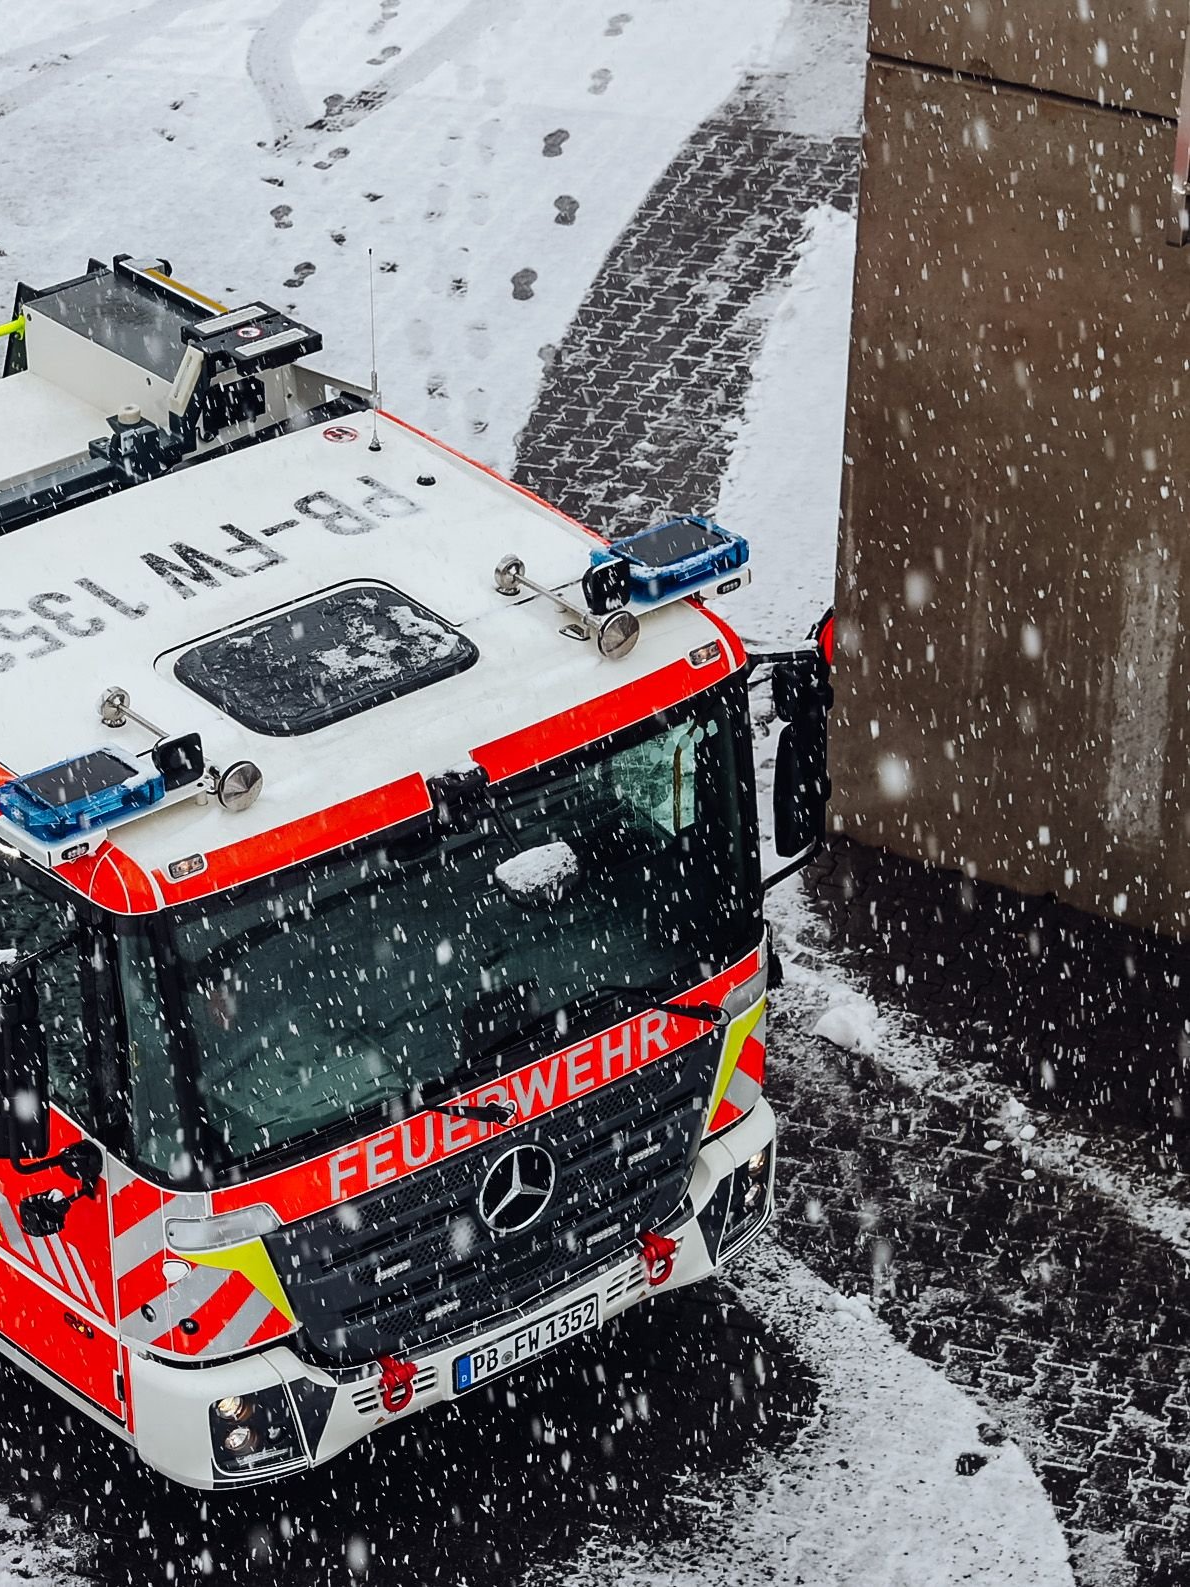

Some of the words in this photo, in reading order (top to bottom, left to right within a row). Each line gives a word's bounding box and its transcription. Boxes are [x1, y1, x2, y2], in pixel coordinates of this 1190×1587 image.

[140, 474, 423, 600] PB-FW
[473, 1348, 499, 1378] PB
[514, 1327, 540, 1359] FW
[545, 1302, 595, 1345] 1352
